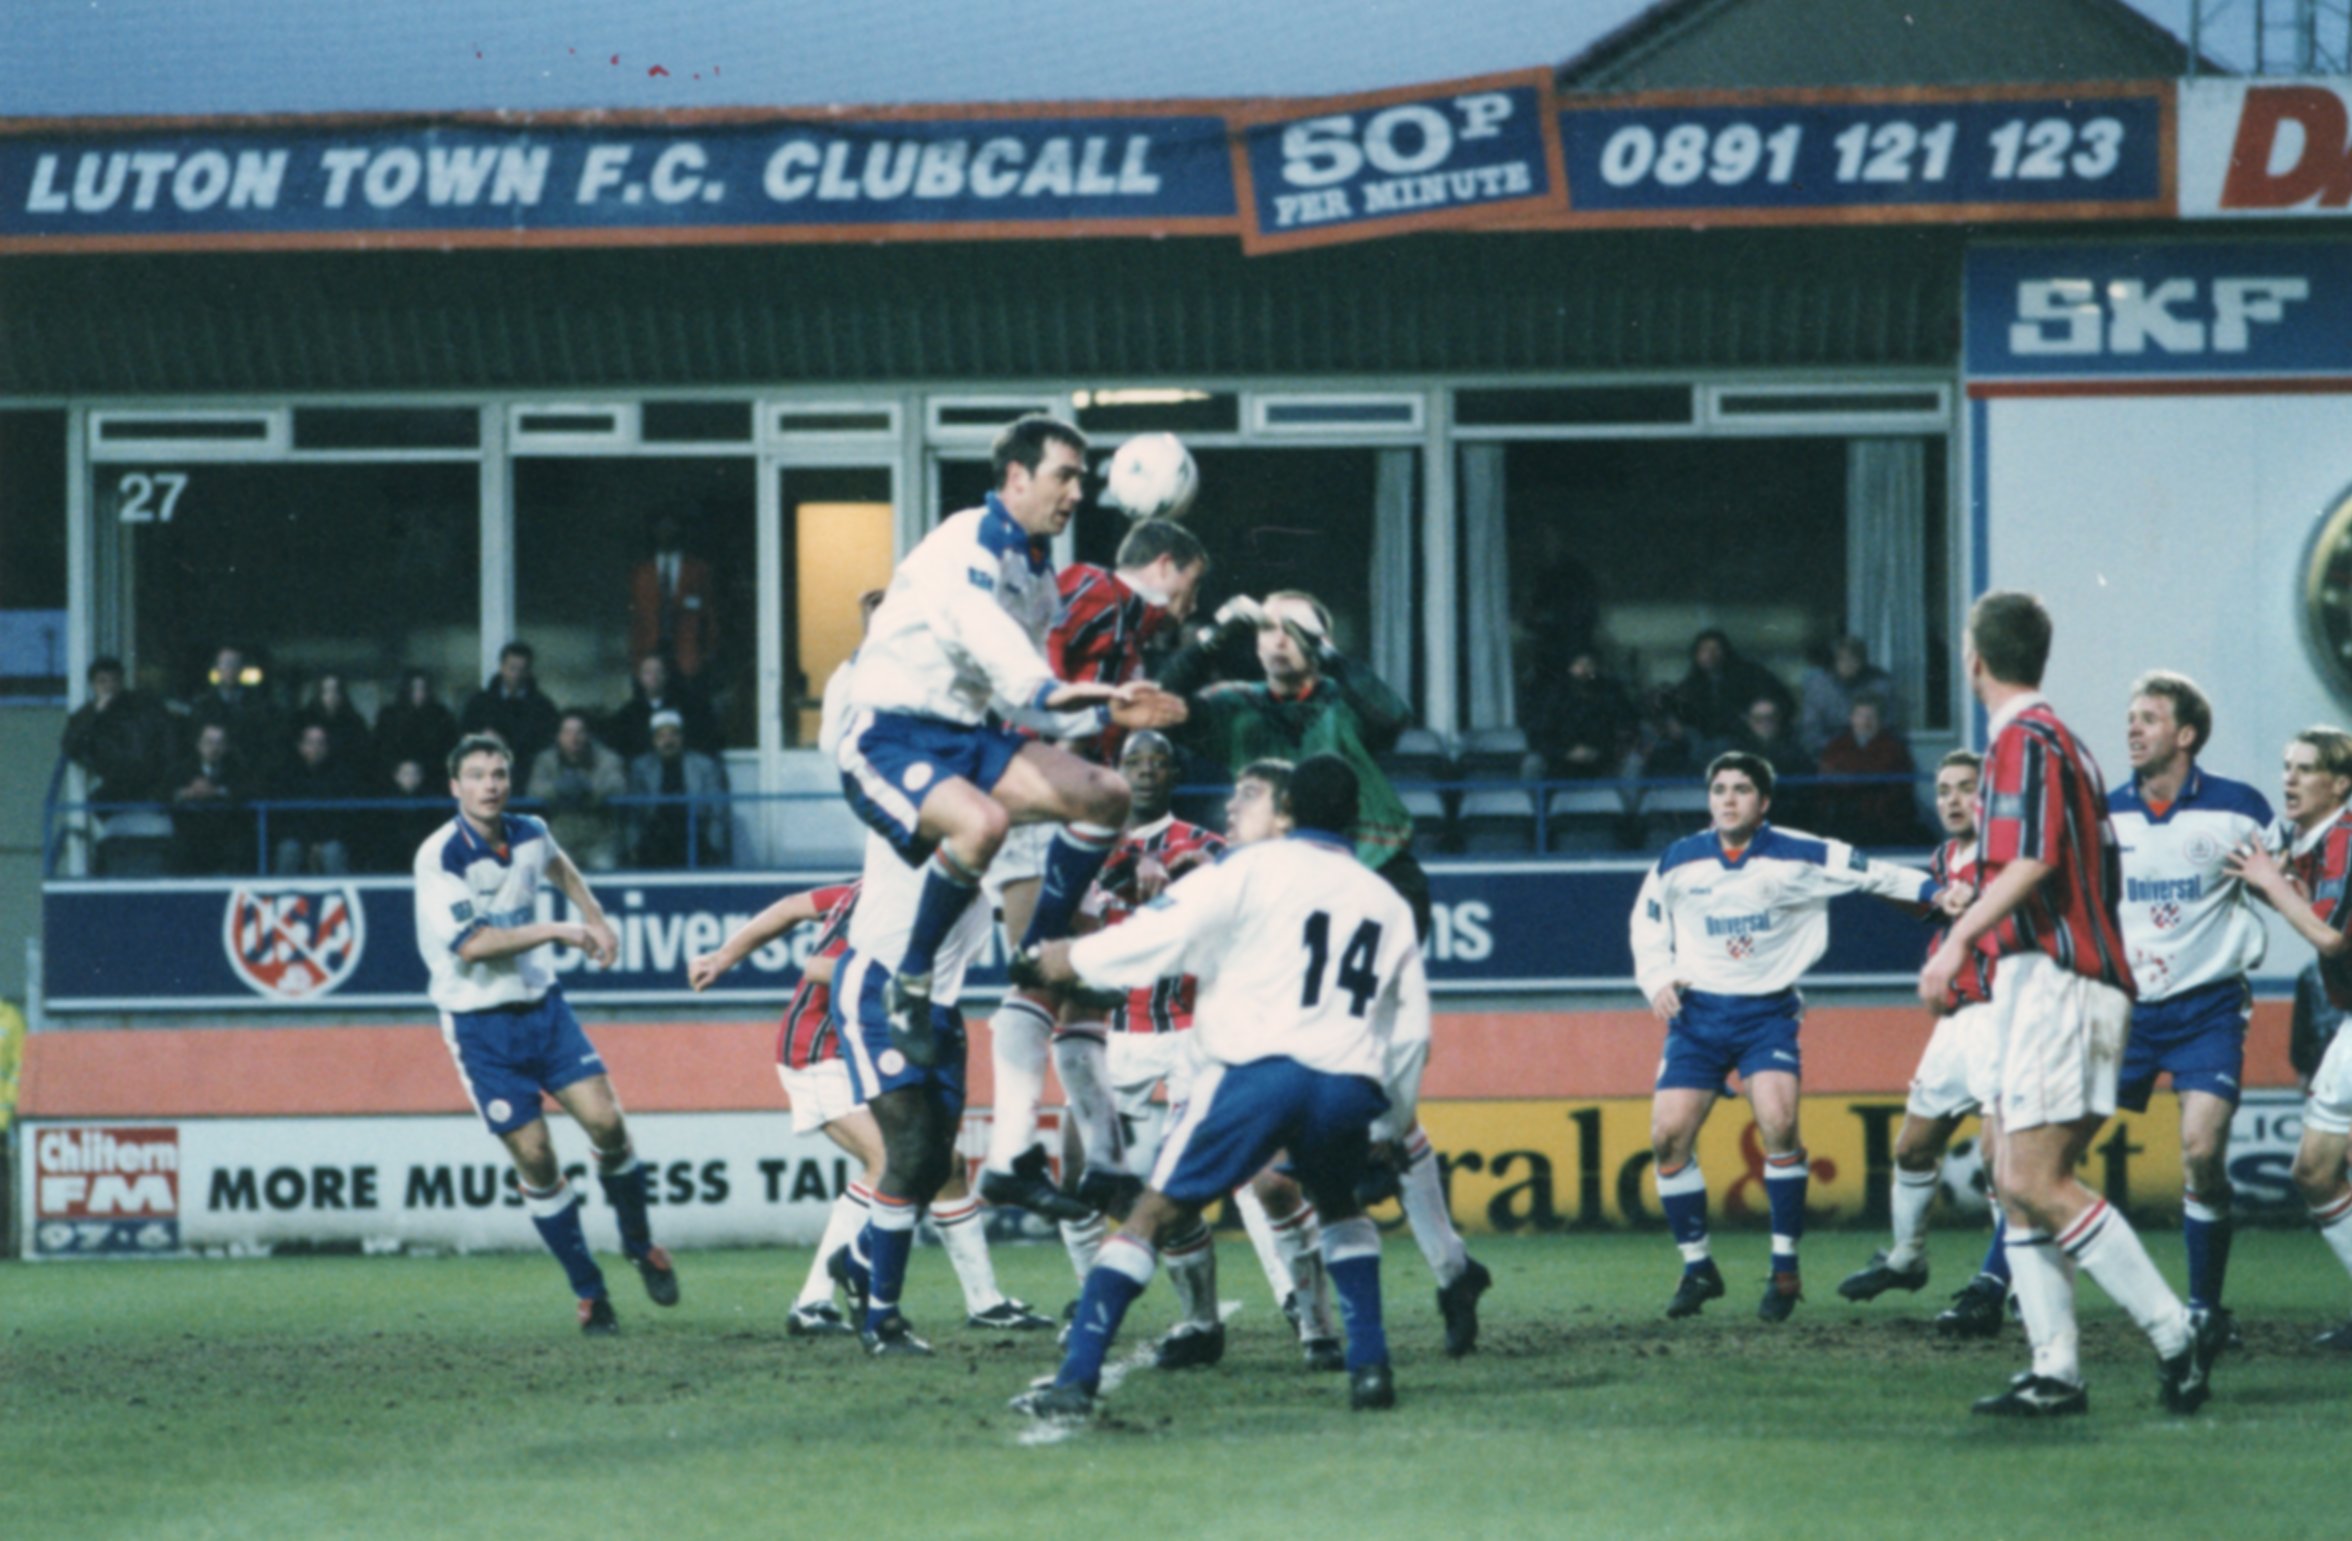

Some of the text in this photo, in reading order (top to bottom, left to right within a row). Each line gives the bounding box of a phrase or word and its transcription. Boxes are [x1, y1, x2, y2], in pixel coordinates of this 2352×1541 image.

[26, 134, 1161, 212] LUTON TOWN F.C. CLUBCALL
[1602, 118, 2124, 186] 0891 121 123
[1274, 161, 1532, 227] PER MINUTE
[2010, 277, 2310, 355] SKF
[119, 471, 188, 523] 27
[2127, 873, 2201, 902] Universal
[1301, 910, 1382, 1018] 14
[40, 1130, 179, 1174] Chiltern
[40, 1175, 175, 1213] FM
[208, 1165, 379, 1211] MORE
